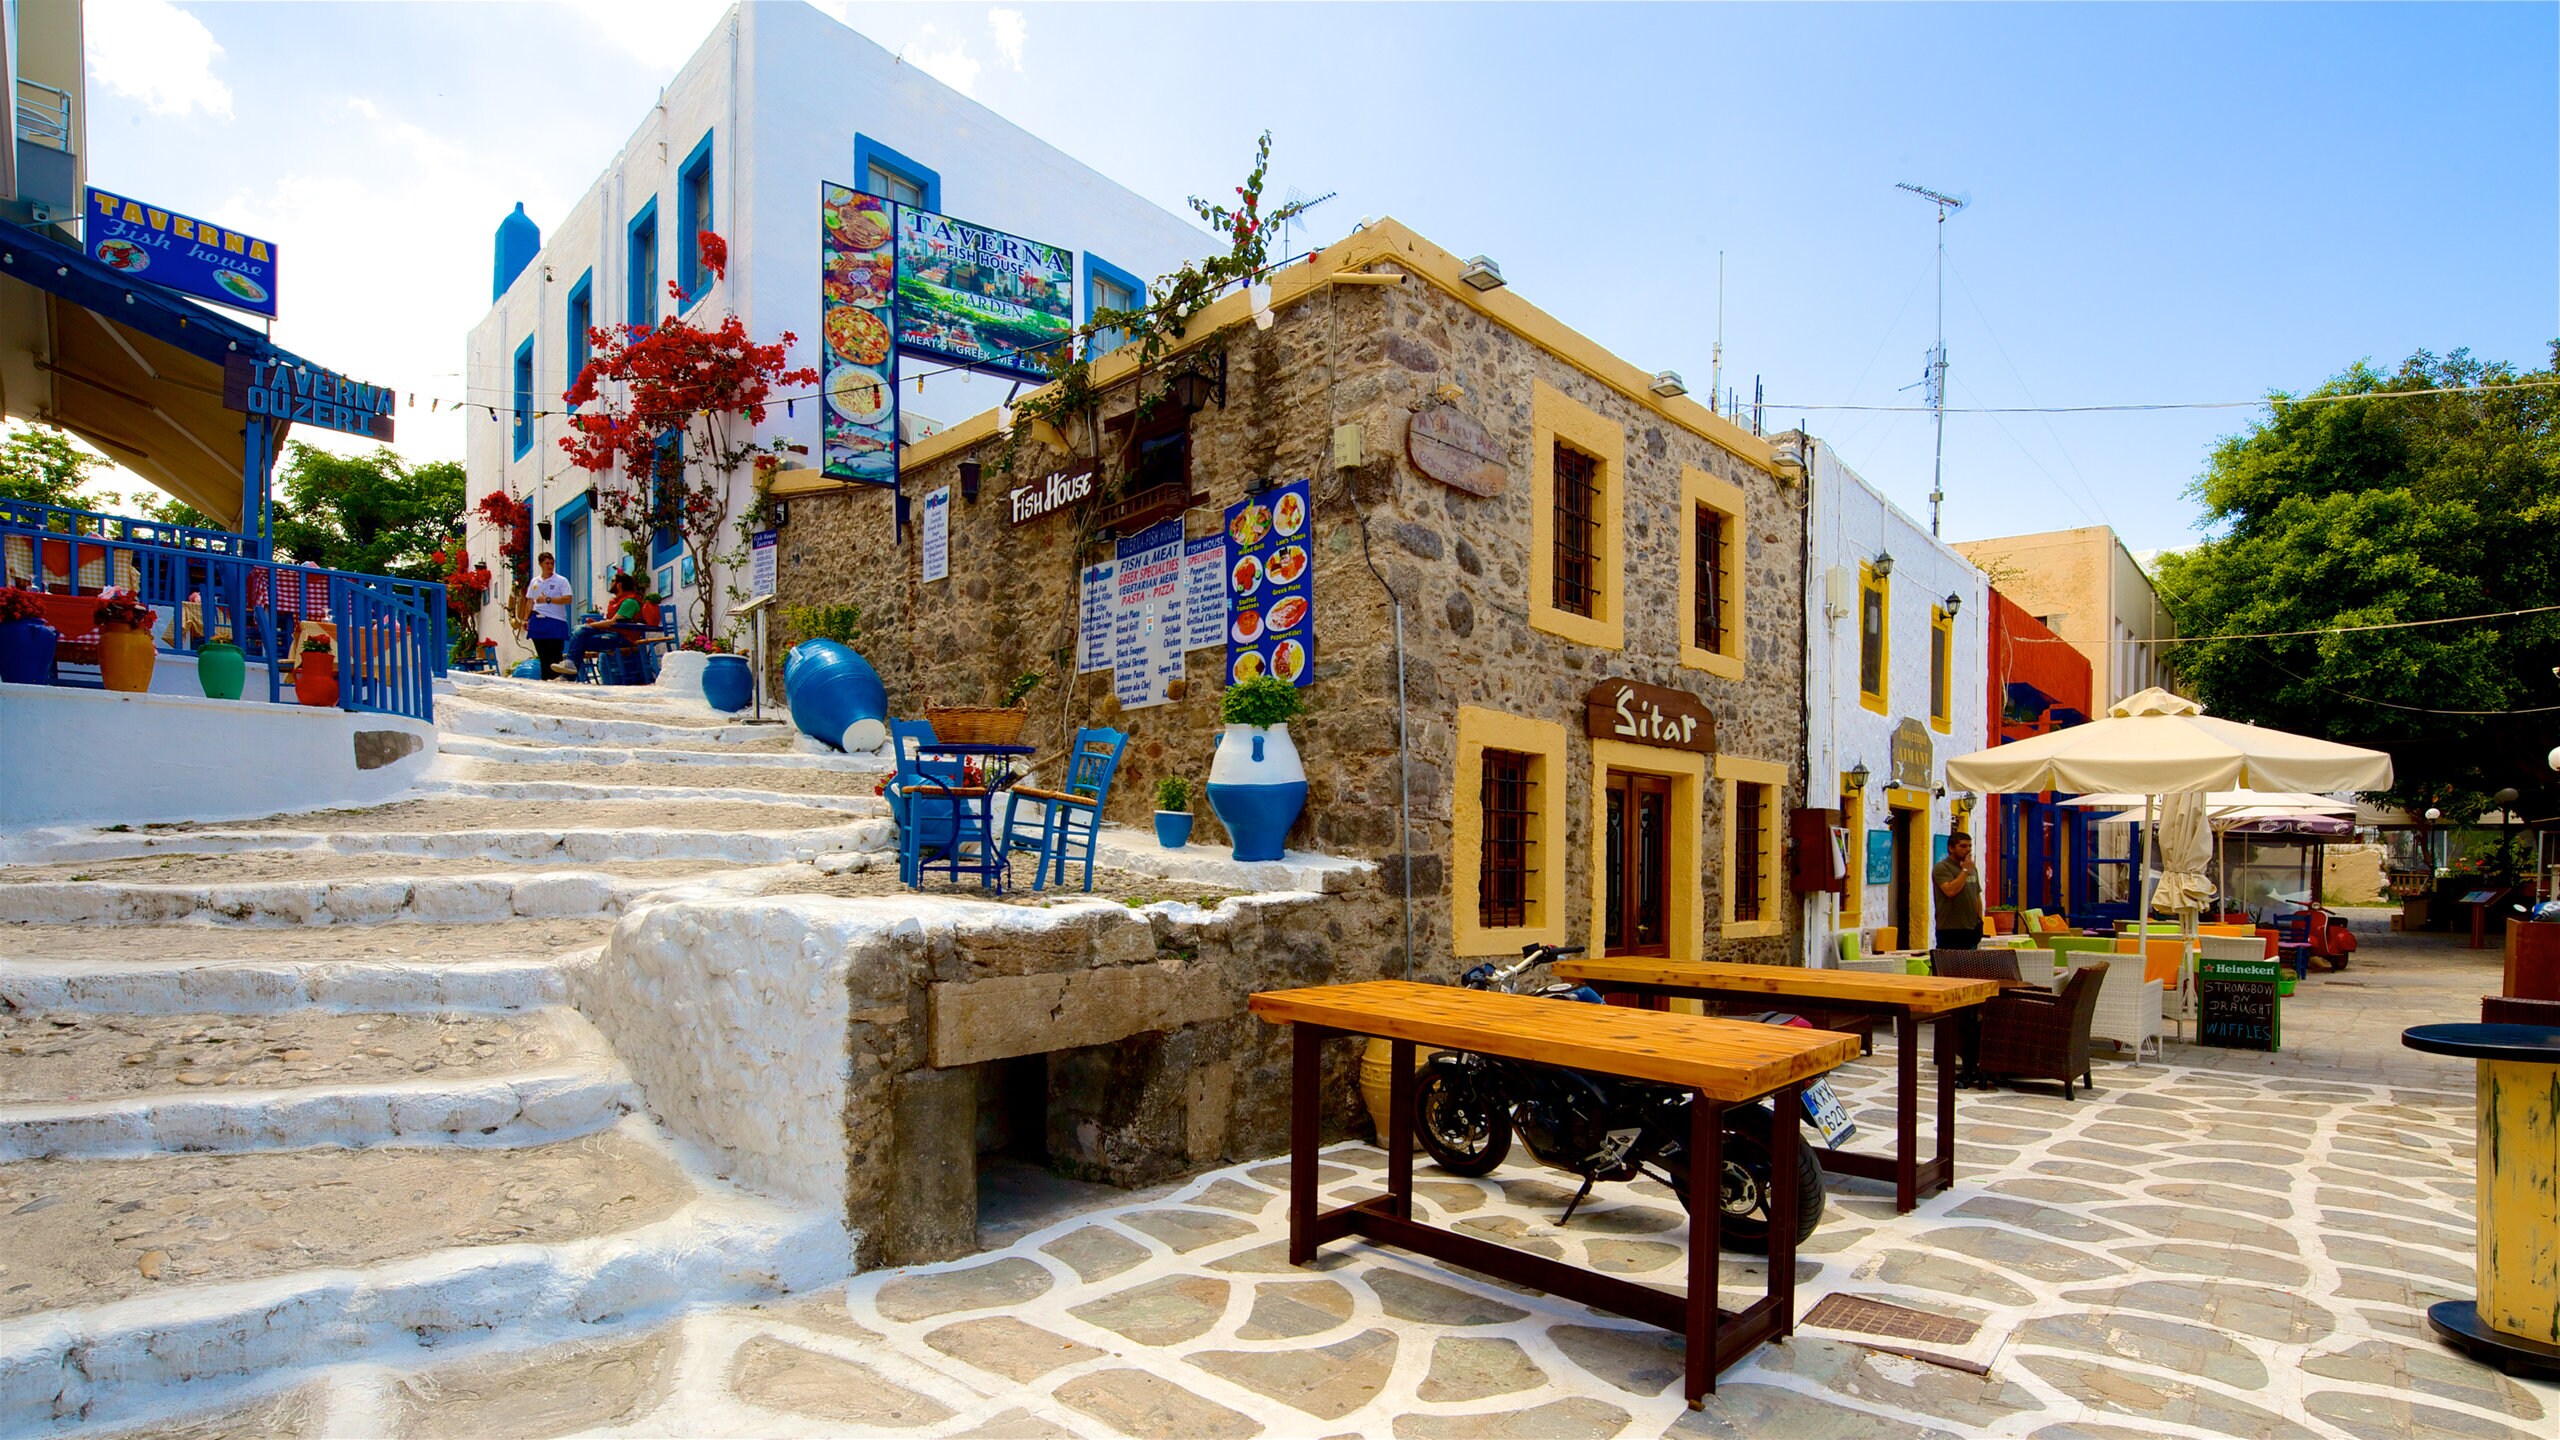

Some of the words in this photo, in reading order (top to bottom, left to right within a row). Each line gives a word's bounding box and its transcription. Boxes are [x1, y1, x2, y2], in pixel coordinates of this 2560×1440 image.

[95, 192, 269, 262] TAVERNA
[104, 219, 170, 250] Fish
[187, 243, 262, 277] house
[907, 211, 1066, 275] TAVERNA
[947, 245, 976, 264] FISH
[979, 250, 1025, 276] HOUSE
[952, 292, 1023, 319] GARDEN
[956, 344, 991, 360] GREEK
[997, 354, 1025, 368] MEE
[250, 359, 393, 416] TAVERNA
[248, 386, 374, 437] OUZERI
[1120, 555, 1142, 573] FISH
[1143, 555, 1149, 566] &
[1151, 544, 1179, 563] MEAT
[1187, 543, 1201, 555] FISH
[1203, 536, 1225, 550] HOUSE
[1119, 570, 1139, 586] GREEK
[1140, 558, 1179, 580] SPECIALTIES
[1119, 577, 1158, 596] VEGETARIAN
[1159, 571, 1179, 584] MENU
[1121, 591, 1145, 607] PASTA
[1153, 583, 1175, 598] PIZZA
[1615, 685, 1697, 743] Sitar
[2216, 964, 2275, 976] Heineken
[2205, 982, 2274, 995] STRONGBOW
[2233, 994, 2250, 1003] ON
[2209, 1000, 2273, 1015] DRAUGHT
[2206, 1023, 2271, 1040] WAFFLES
[1810, 1083, 1834, 1109] KXX
[1825, 1105, 1847, 1131] 620
